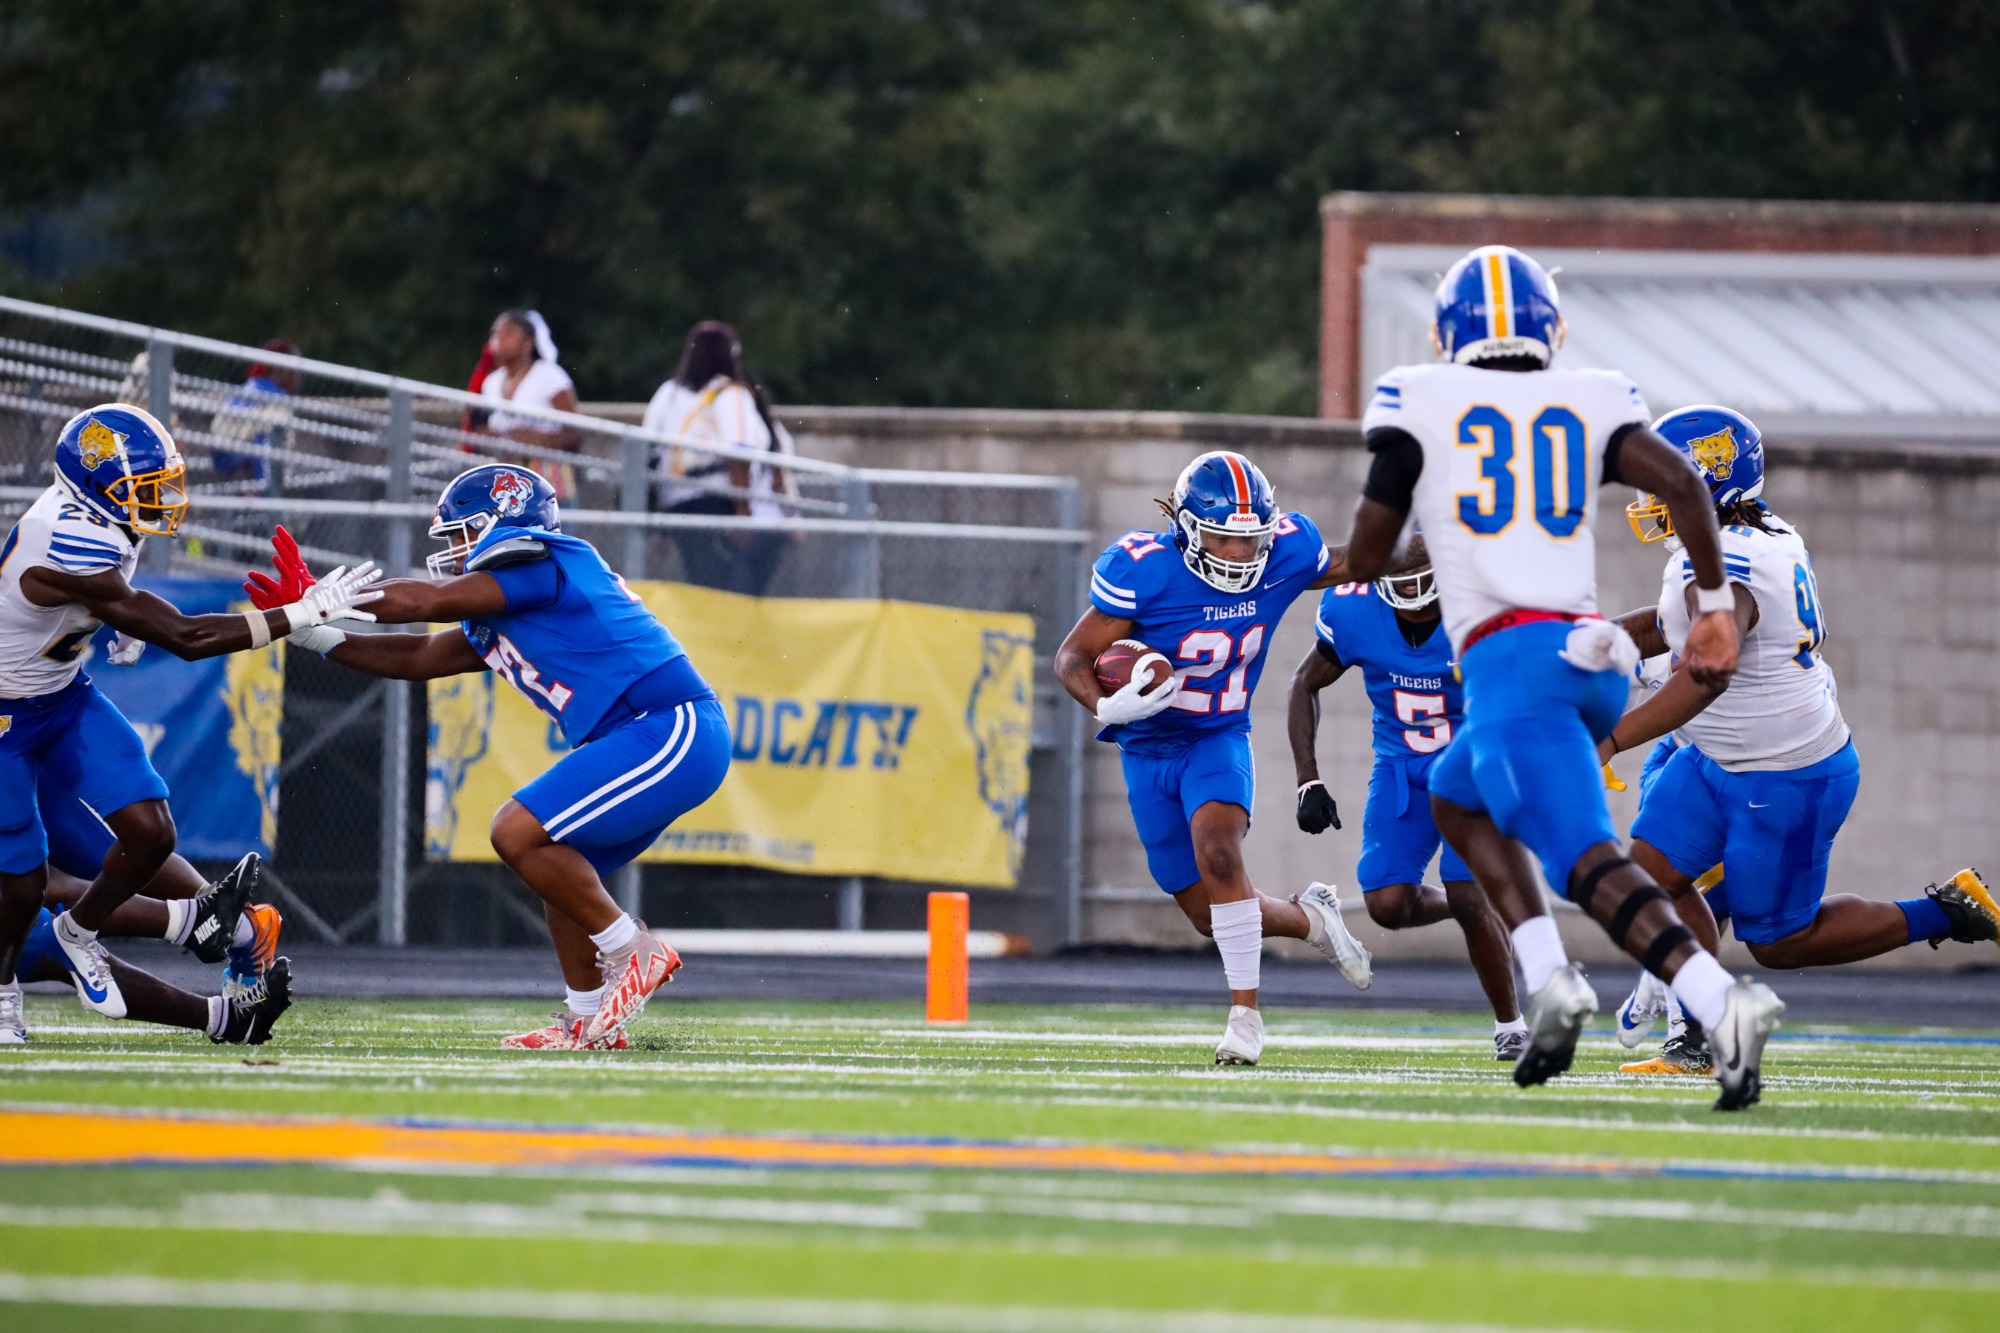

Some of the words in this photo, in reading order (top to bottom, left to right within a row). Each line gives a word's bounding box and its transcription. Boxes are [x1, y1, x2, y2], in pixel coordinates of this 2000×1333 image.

[1454, 404, 1588, 541] 30
[1231, 515, 1257, 523] Riddell
[1116, 530, 1167, 562] 21
[1203, 600, 1257, 622] TIGERS
[1168, 623, 1266, 716] 21
[1388, 671, 1443, 690] TIGERS
[1393, 688, 1454, 755] 5
[193, 913, 222, 945] NIKE
